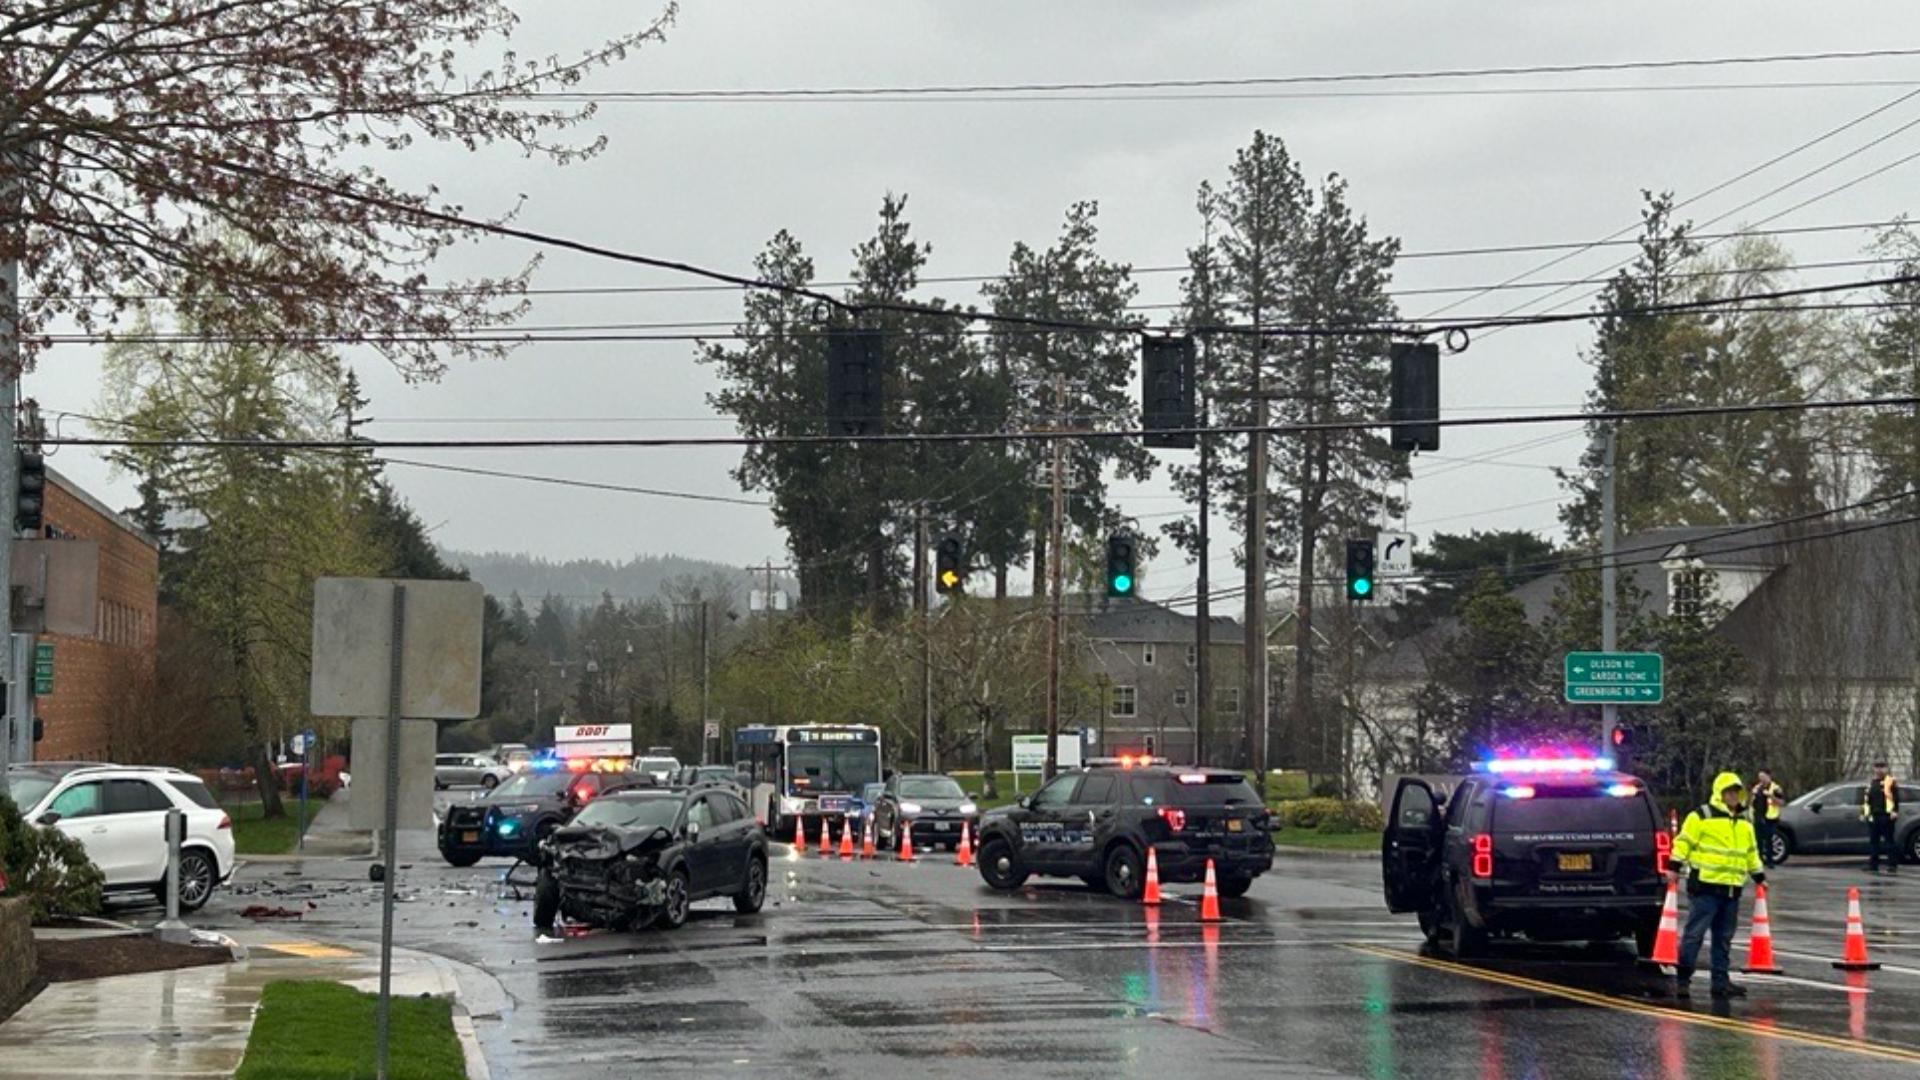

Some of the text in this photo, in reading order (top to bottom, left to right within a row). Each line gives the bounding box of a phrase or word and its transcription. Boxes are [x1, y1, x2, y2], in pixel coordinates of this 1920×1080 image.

[1381, 561, 1406, 570] ONLY
[1590, 671, 1623, 680] GARDEN
[1591, 831, 1634, 840] POLICE
